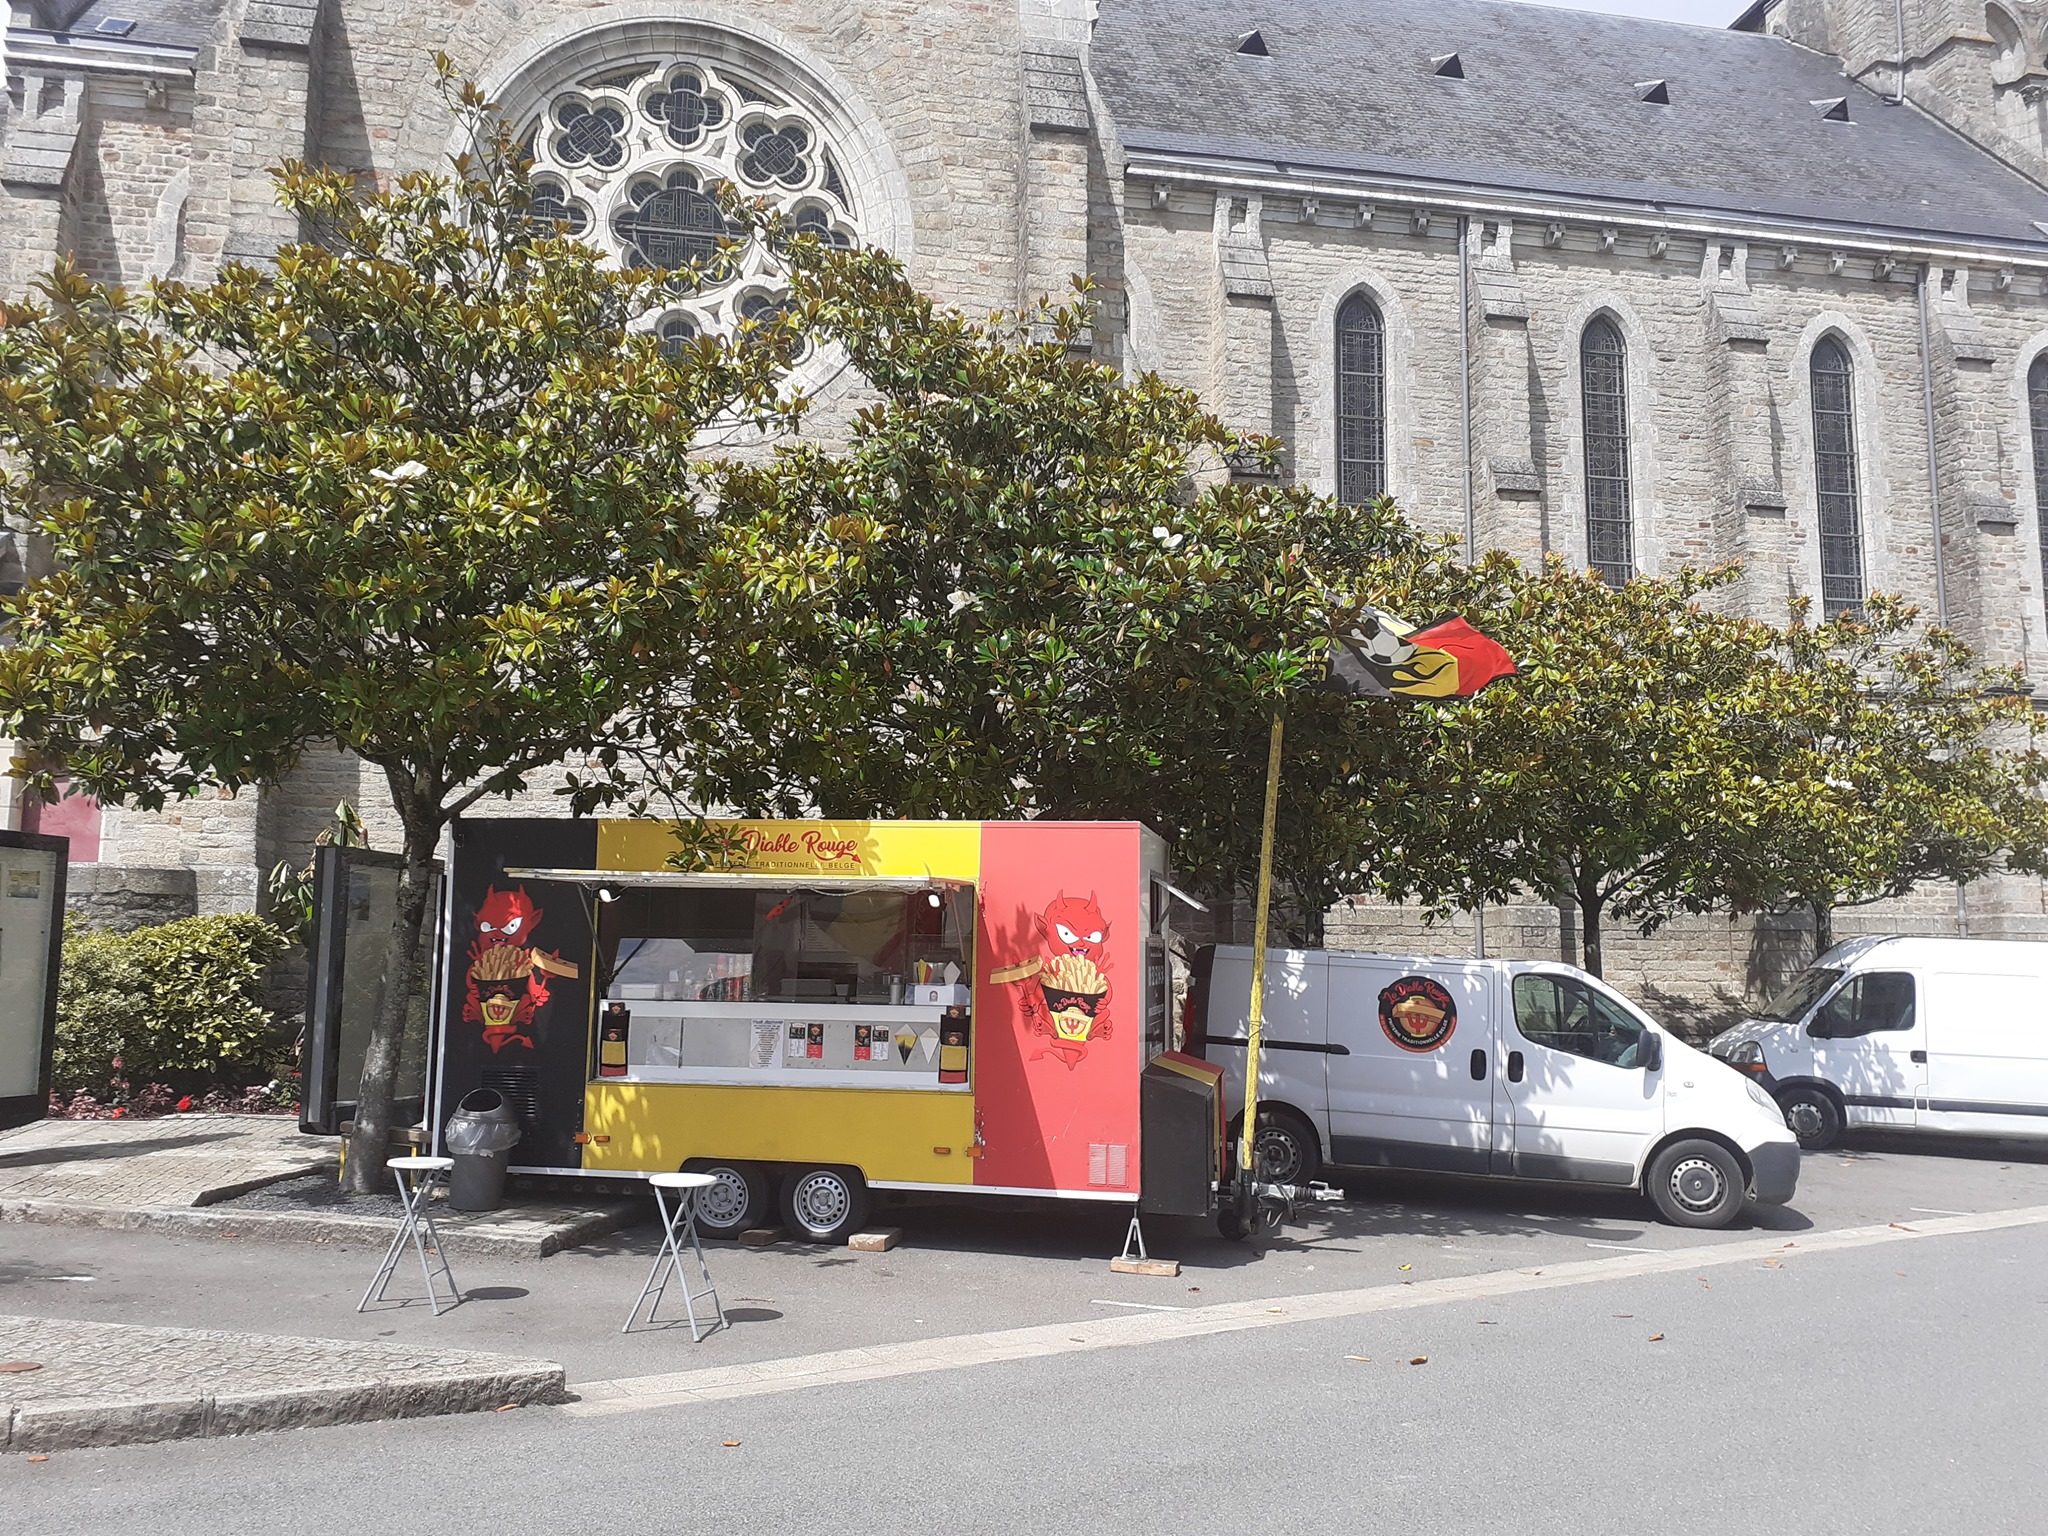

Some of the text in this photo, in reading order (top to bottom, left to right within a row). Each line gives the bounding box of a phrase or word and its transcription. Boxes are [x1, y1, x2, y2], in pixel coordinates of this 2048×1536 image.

[742, 830, 799, 853] Diable
[801, 830, 860, 861] Rouge
[1395, 981, 1424, 996] Diable
